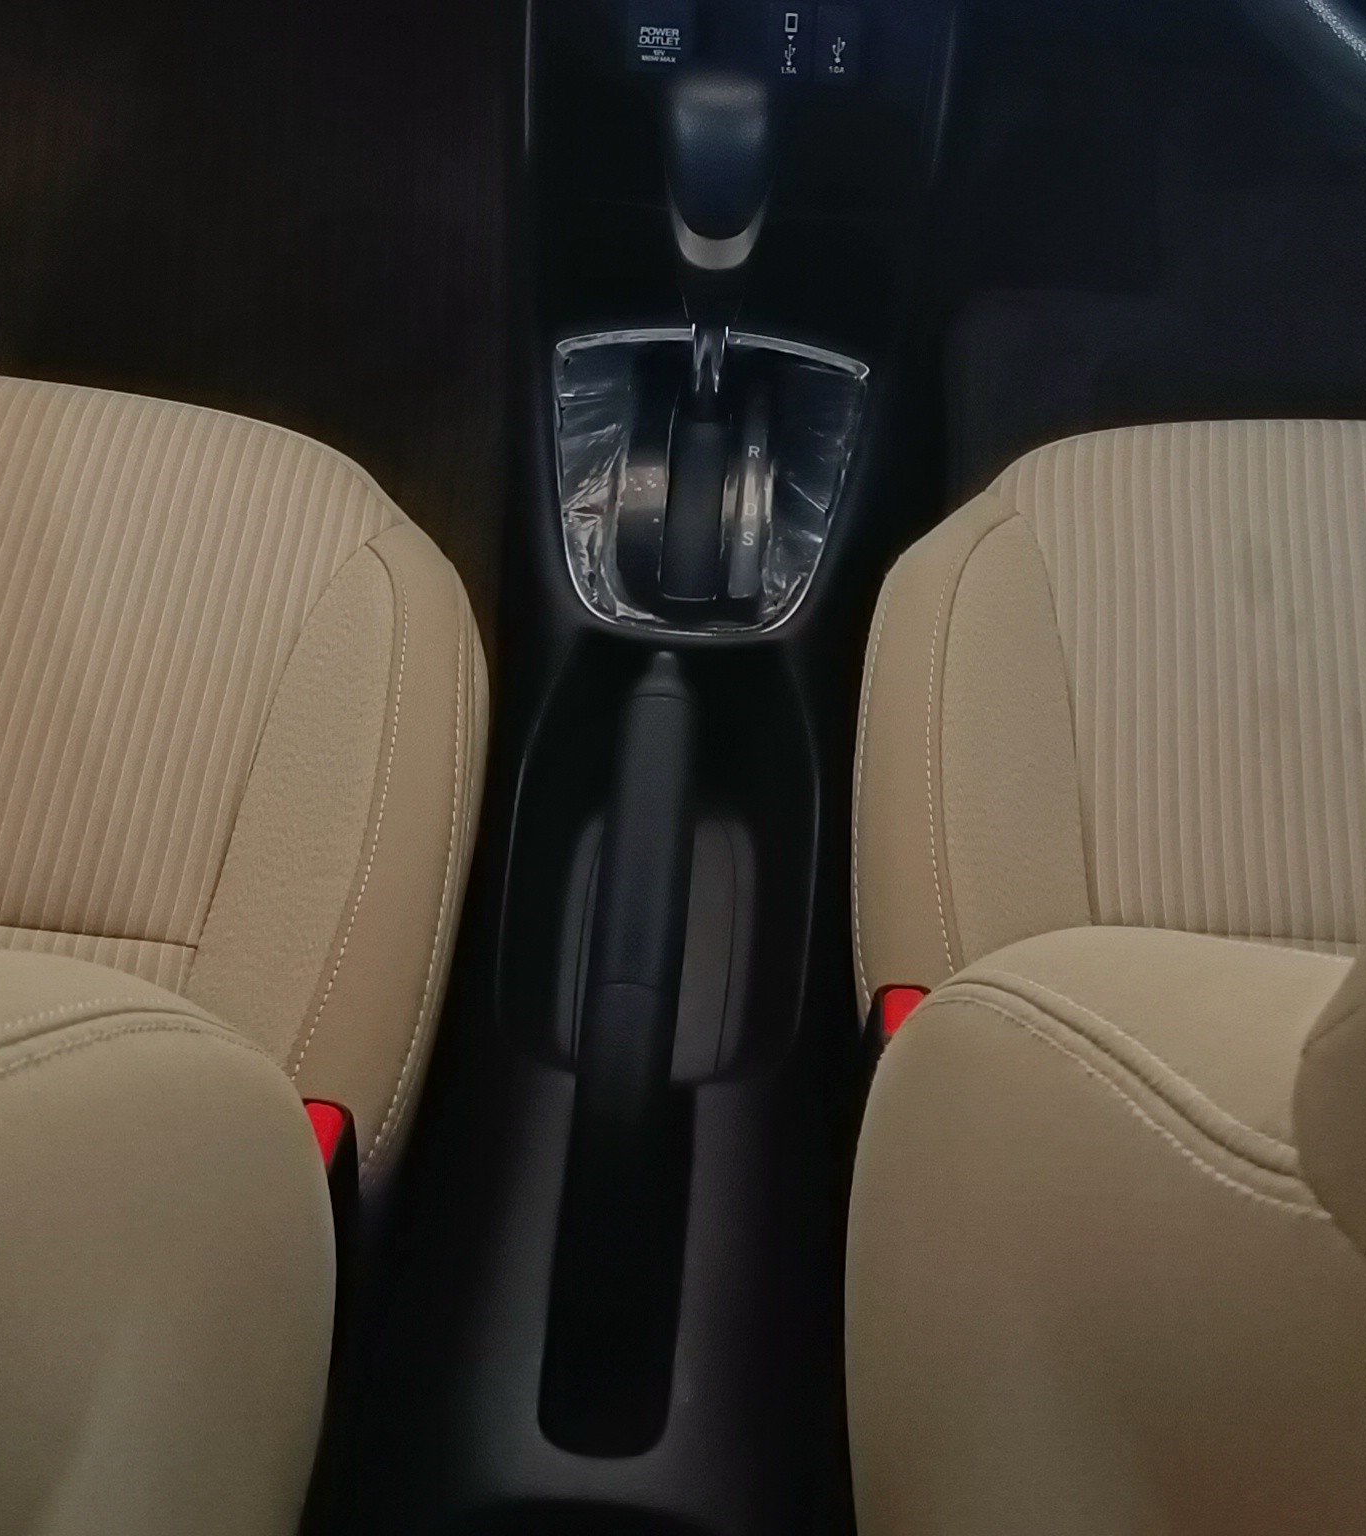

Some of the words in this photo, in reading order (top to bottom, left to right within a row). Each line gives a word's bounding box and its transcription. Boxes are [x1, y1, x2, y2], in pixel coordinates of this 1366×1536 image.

[640, 26, 679, 37] POWER
[638, 35, 681, 45] OUTLET
[747, 445, 760, 458] R
[744, 503, 757, 516] D
[742, 531, 754, 546] S
